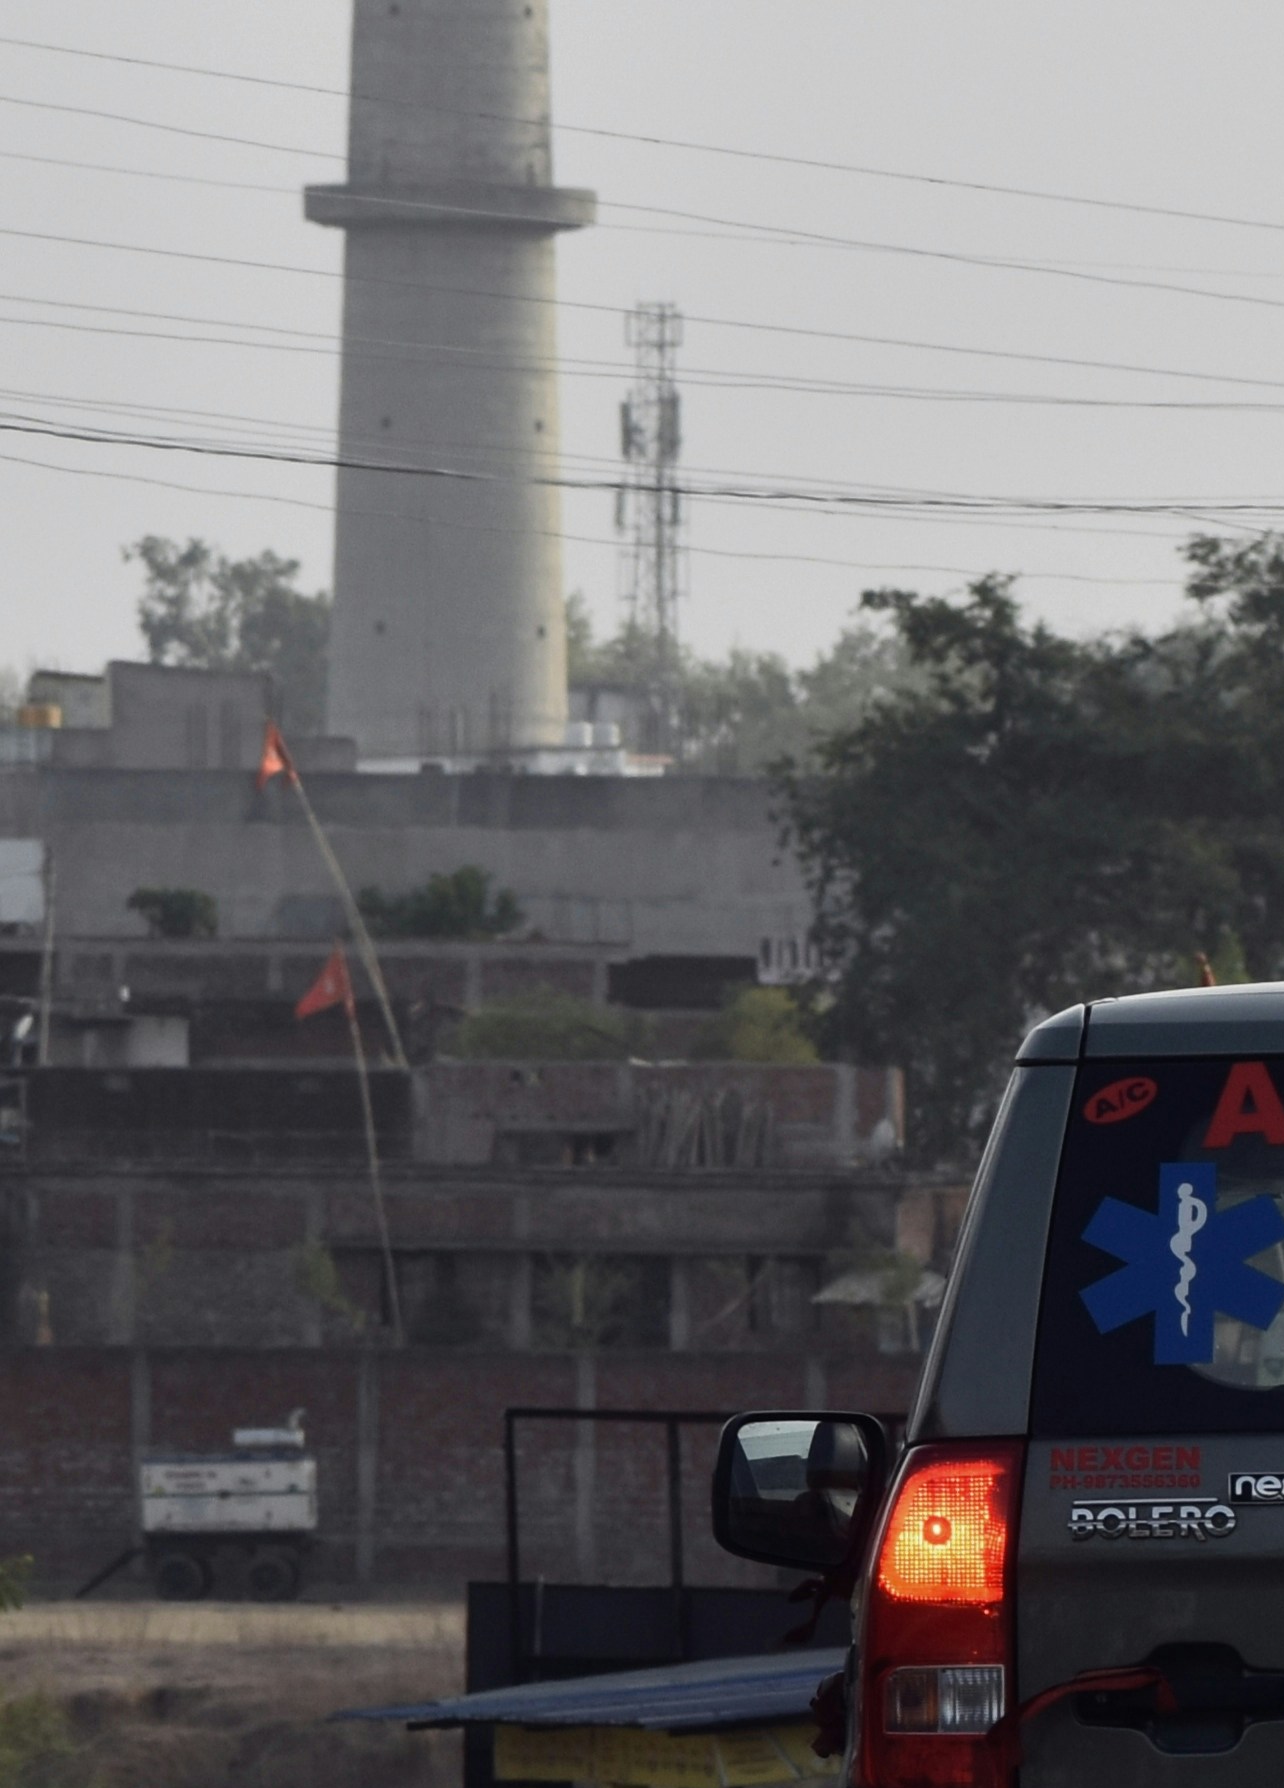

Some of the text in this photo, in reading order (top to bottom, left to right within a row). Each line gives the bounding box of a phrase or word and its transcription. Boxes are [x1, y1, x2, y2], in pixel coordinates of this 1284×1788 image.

[1095, 1081, 1150, 1119] A/C
[1050, 1446, 1201, 1472] NEXGEN
[1068, 1504, 1237, 1542] BOLERO
